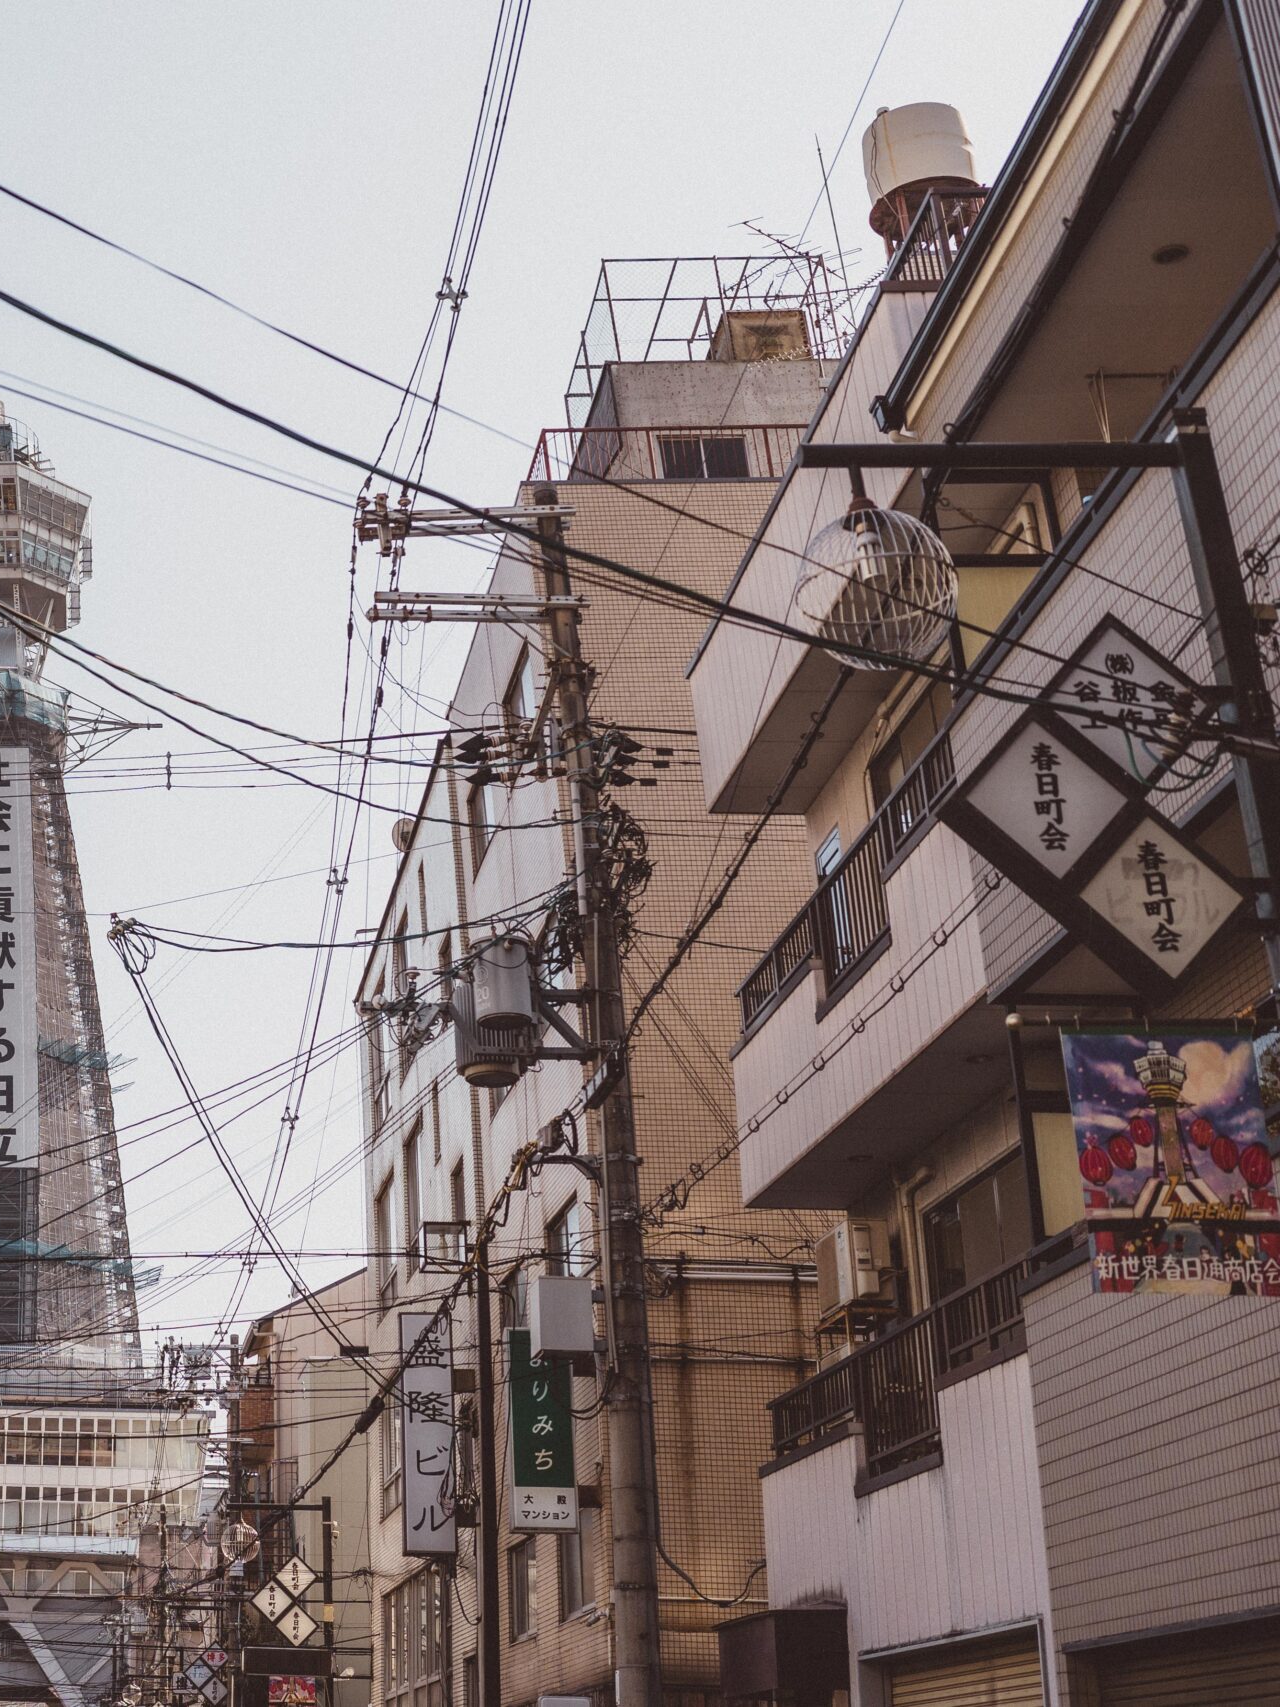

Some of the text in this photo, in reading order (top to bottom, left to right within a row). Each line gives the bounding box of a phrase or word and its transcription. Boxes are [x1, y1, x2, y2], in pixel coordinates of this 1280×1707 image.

[1030, 742, 1070, 851] 春日町会
[1137, 840, 1182, 952] 春日町会
[408, 1336, 450, 1532] 盛隆ビル
[521, 1510, 570, 1520] マンション
[291, 1562, 300, 1590] 春日町会
[292, 1612, 300, 1640] 春日町会
